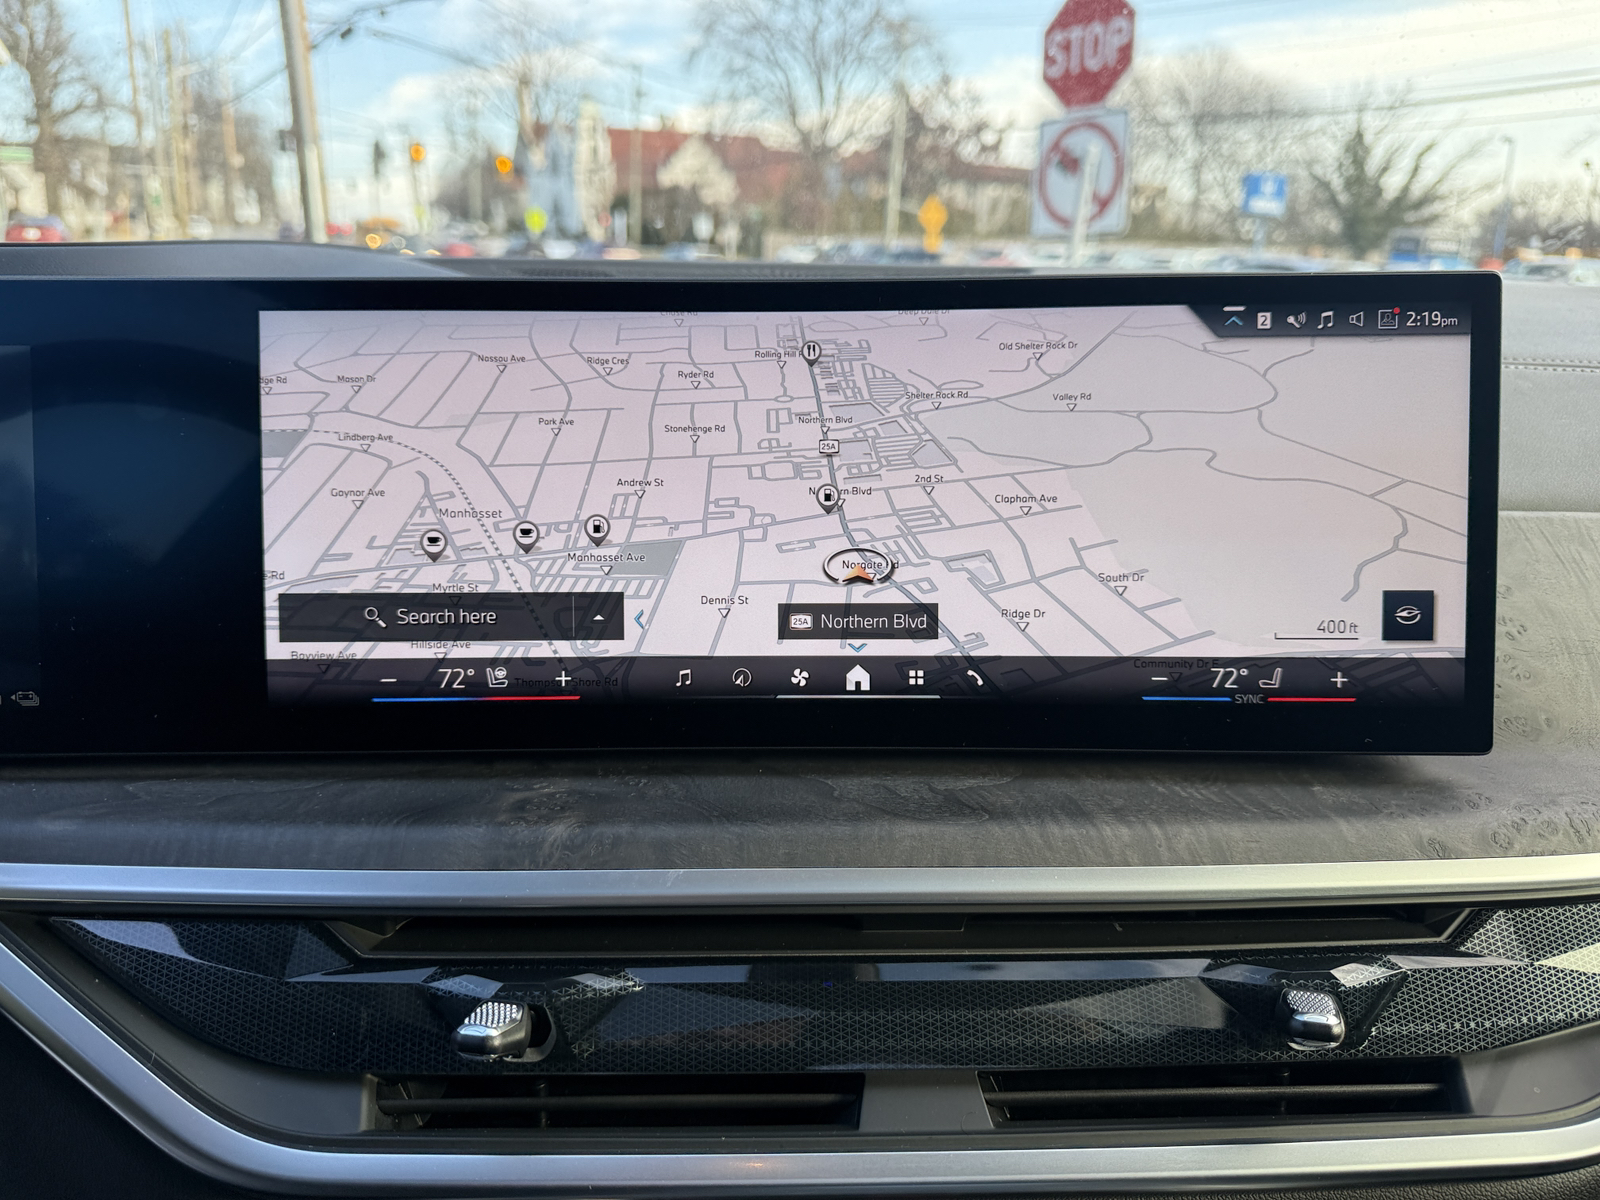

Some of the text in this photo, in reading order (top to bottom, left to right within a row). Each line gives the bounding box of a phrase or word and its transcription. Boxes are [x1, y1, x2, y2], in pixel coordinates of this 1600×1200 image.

[1044, 15, 1132, 79] STOP
[1406, 311, 1458, 328] 2:19pm
[998, 342, 1078, 350] Old Shelter Rock Dr
[510, 354, 526, 362] Ave
[754, 350, 782, 360] Rolling
[784, 350, 796, 358] Hill
[586, 356, 630, 366] Ridge Cres
[276, 376, 288, 384] Rd
[337, 375, 376, 383] Mason Dr
[678, 370, 714, 380] Ryder Rd
[906, 392, 934, 400] Shelter
[936, 391, 955, 399] Rock
[1052, 392, 1092, 402] Valley Rd
[538, 418, 574, 426] Park Ave
[835, 416, 853, 424] Blvd
[664, 424, 726, 434] Stonehenge Rd
[338, 434, 394, 442] Lindberg Ave
[821, 443, 836, 451] 25A
[616, 478, 664, 487] Andrew St
[914, 474, 944, 483] 2nd St
[330, 488, 386, 498] Gaynor Ave
[852, 487, 872, 496] Blvd
[994, 494, 1058, 504] Clapham Ave
[438, 508, 502, 519] Manhasset
[567, 553, 646, 562] Manhasset Ave
[271, 570, 285, 580] Rd
[1098, 572, 1144, 582] South Dr
[432, 583, 479, 593] Myrtle St
[700, 596, 749, 605] Dennis St
[397, 608, 497, 624] Search here
[1001, 608, 1046, 620] Ridge Dr
[792, 614, 926, 629] 25A Northern Blvd
[411, 641, 472, 649] Hillside Ave
[290, 650, 358, 662] Bayview Ave
[1133, 658, 1194, 671] Community
[1196, 658, 1210, 669] Dr
[438, 668, 475, 688] 72°
[572, 677, 602, 687] Shore
[604, 677, 618, 687] Rd
[1210, 668, 1249, 689] 72°
[1234, 694, 1265, 704] SYNC
